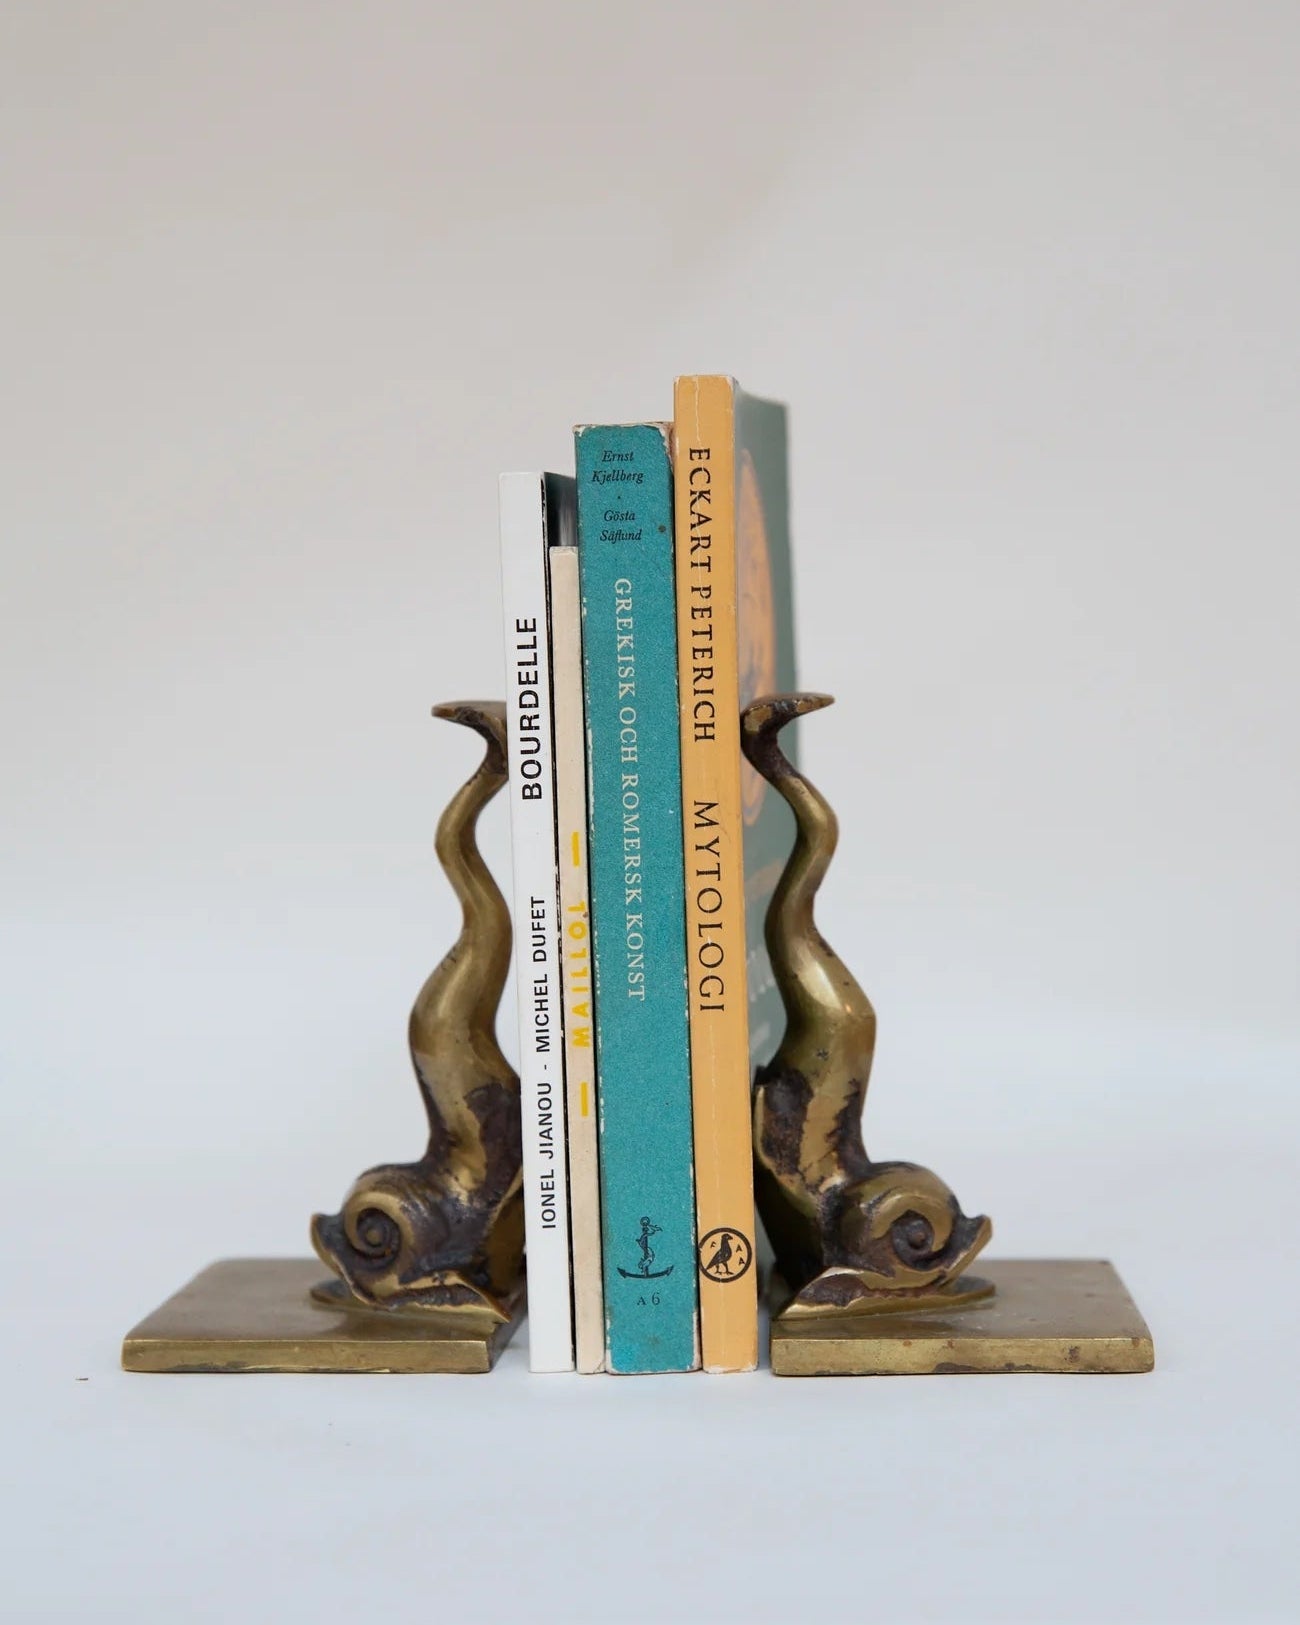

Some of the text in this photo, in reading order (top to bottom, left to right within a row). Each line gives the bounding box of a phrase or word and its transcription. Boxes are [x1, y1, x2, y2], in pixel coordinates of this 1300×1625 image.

[592, 470, 643, 485] Kjellberg
[602, 451, 633, 462] Ernst
[600, 529, 642, 544] Säflund
[604, 510, 635, 521] Gösta
[516, 618, 541, 799] BOURDELLE
[690, 448, 724, 1011] ECKART PETERICH MYTOLOGI
[615, 579, 644, 1002] GREKISK OCH ROMERSK KONST
[531, 897, 546, 962] DUFET
[569, 902, 589, 1047] MAILLOL
[534, 974, 549, 1052] MICHEL
[538, 1083, 553, 1159] JIANOU
[541, 1169, 555, 1228] IONEL
[636, 1291, 661, 1306] A 6
